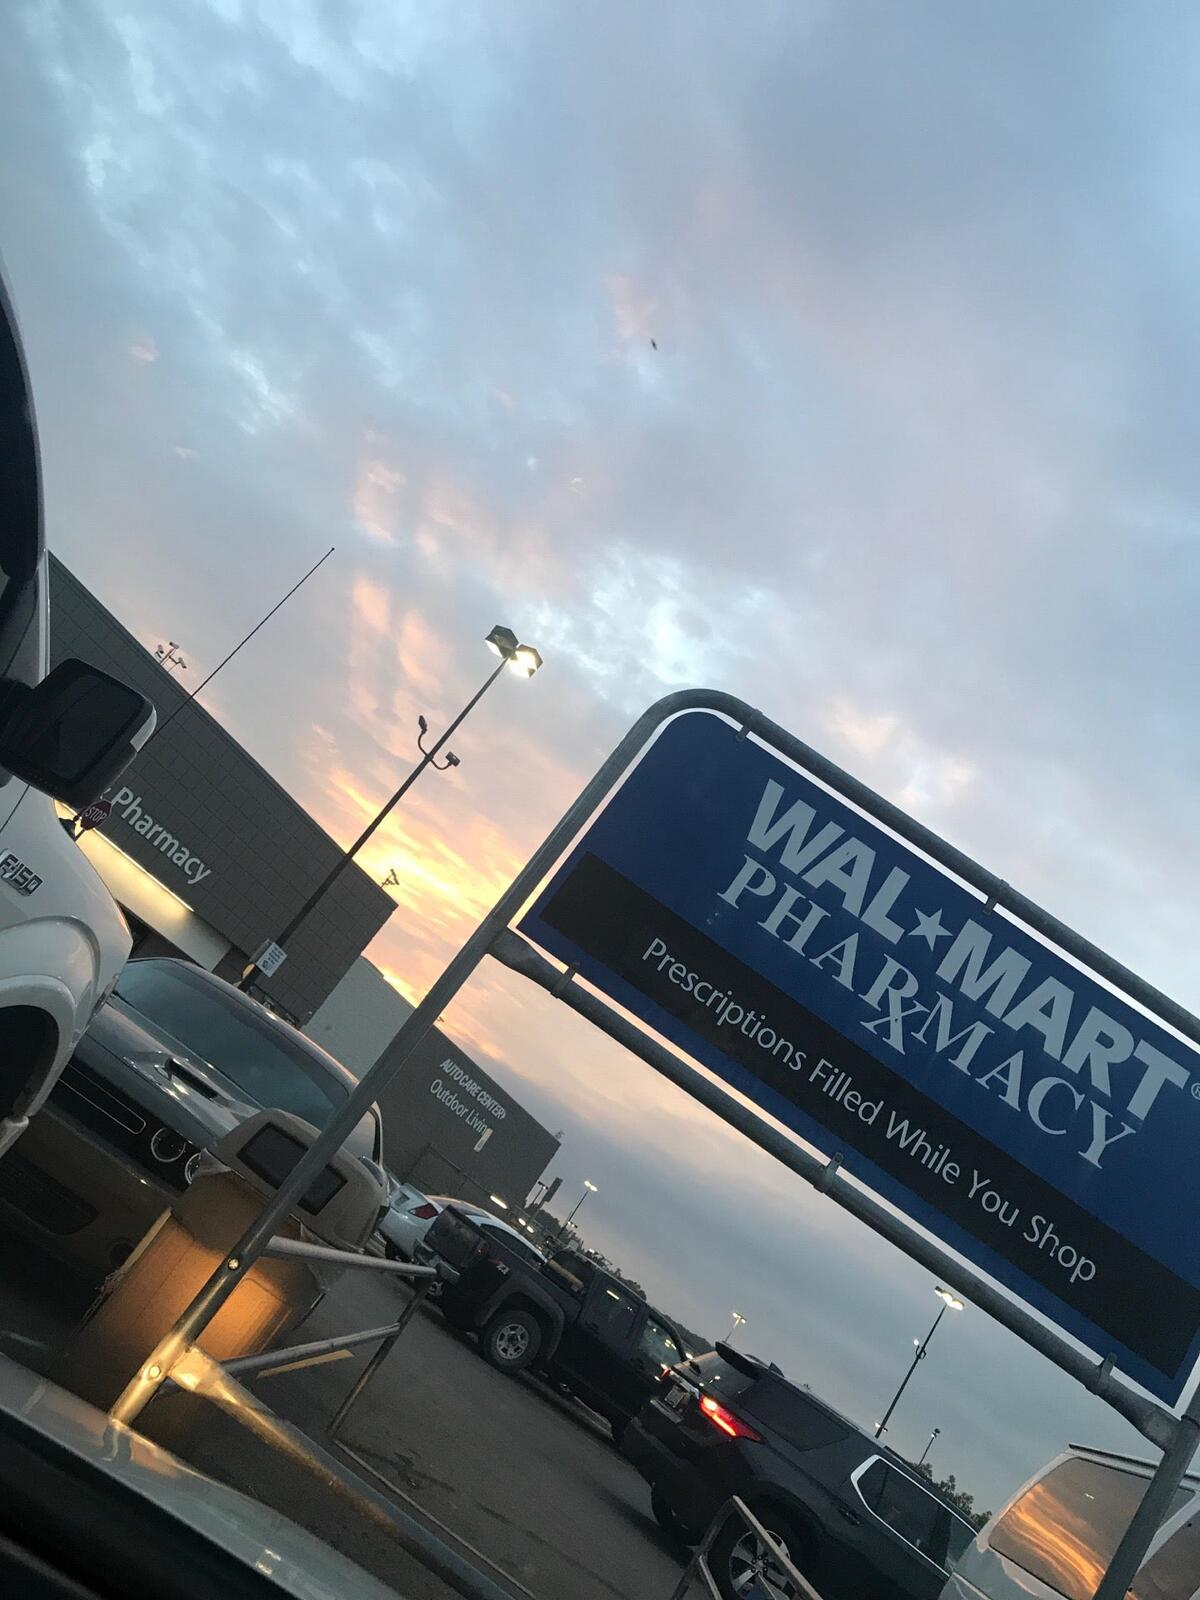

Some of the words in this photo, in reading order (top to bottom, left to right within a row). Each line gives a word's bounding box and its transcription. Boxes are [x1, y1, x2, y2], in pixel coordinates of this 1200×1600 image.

[85, 806, 108, 823] STOP
[111, 786, 212, 884] Pharmacy
[717, 854, 1137, 1169] PHARMACY
[430, 1079, 469, 1118] Outdoor
[465, 1109, 491, 1136] Livin
[440, 1058, 464, 1081] AUTO
[459, 1075, 482, 1097] CARE
[477, 1090, 506, 1120] CENTER
[642, 937, 807, 1072] Prescriptions
[808, 1058, 884, 1126] Filled
[885, 1110, 961, 1185] While
[968, 1169, 1020, 1227] You
[1023, 1214, 1096, 1284] Shop
